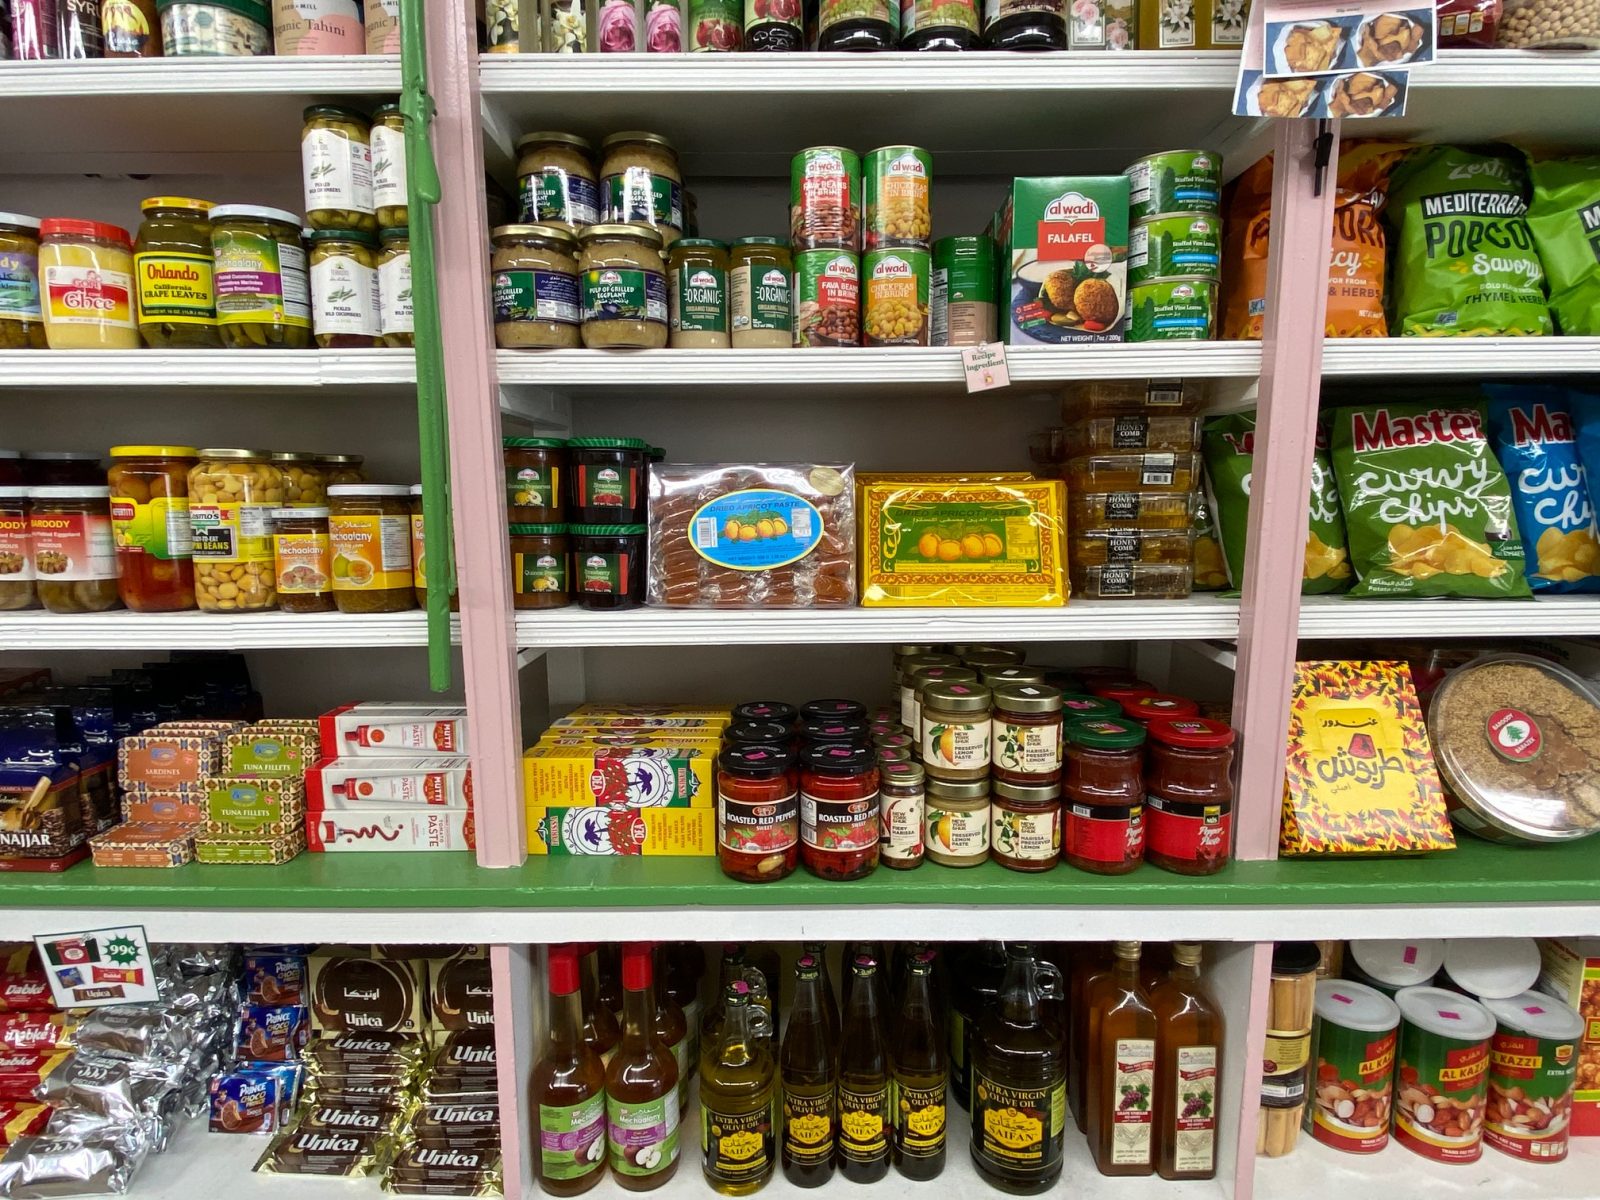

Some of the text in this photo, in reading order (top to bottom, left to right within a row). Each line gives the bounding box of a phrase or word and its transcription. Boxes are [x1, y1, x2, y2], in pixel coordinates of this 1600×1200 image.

[304, 19, 346, 37] Tahini
[892, 161, 922, 173] al wadi
[1050, 202, 1093, 215] al wadi
[1047, 233, 1095, 244] FALAFEL
[829, 262, 856, 274] al wadi
[1328, 248, 1362, 276] icy
[148, 264, 199, 281] Orlando
[876, 263, 908, 274] al wadi
[1472, 254, 1542, 287] Savory
[502, 287, 523, 295] GRILLED
[611, 286, 635, 294] GRILLED
[822, 281, 859, 292] FAVA BEANS
[870, 282, 915, 292] CHICKPEAS
[1342, 287, 1381, 298] HERBS
[145, 290, 207, 300] GRAPE LEAVES
[597, 292, 626, 300] EGGPLANT
[687, 289, 720, 304] ORGANIC
[759, 287, 789, 304] ORGANIC
[838, 289, 856, 300] BRINE
[885, 289, 910, 298] BRINE
[1465, 293, 1509, 305] THYME
[63, 290, 115, 310] Ghee
[971, 352, 996, 362] Recipe
[1352, 408, 1487, 453] Master
[709, 504, 735, 512] DRIED
[736, 502, 773, 511] APRICOT
[31, 519, 71, 528] BAROODY
[203, 540, 229, 550] BEANS
[1321, 717, 1378, 728] غندور
[412, 725, 421, 746] PASTE
[1316, 745, 1405, 790] طربوش
[402, 778, 410, 800] PASTE
[591, 776, 602, 790] DEA
[727, 809, 797, 825] ROASTED RED PEPPERS
[819, 812, 866, 823] ROASTED RED
[428, 815, 439, 847] PASTE
[634, 824, 644, 839] DEA
[0, 833, 51, 849] NAJJAR
[110, 945, 136, 956] 99¢
[275, 961, 299, 973] PRINCE
[266, 1012, 290, 1025] PRINCE
[345, 1013, 383, 1027] Unica
[334, 1037, 392, 1051] Unica
[1361, 1063, 1374, 1071] AL
[1500, 1056, 1537, 1067] KAZZI
[1442, 1071, 1456, 1079] AL
[239, 1082, 267, 1096] PRINCE
[904, 1090, 928, 1100] EXTRA
[981, 1079, 1047, 1100] EXTRA VIRGIN
[240, 1092, 267, 1104] CHOCO
[810, 1093, 833, 1106] VIRGIN
[862, 1092, 886, 1104] VIRGIN
[911, 1097, 933, 1106] OLIVE
[988, 1091, 1037, 1108] OLIVE OIL
[792, 1103, 827, 1113] OLIVE OIL
[844, 1101, 880, 1110] OLIVE OIL
[320, 1107, 380, 1127] Unica
[434, 1104, 494, 1123] Unica
[715, 1110, 766, 1125] EXTRA VIRGIN
[722, 1120, 759, 1131] OLIVE OIL
[913, 1119, 944, 1130] SAIFAN
[792, 1128, 826, 1138] SAIFAN
[845, 1127, 878, 1136] SAIFAN
[988, 1125, 1035, 1142] SAIFAN
[299, 1133, 360, 1152] Unica
[723, 1144, 759, 1155] SAIFAN
[417, 1148, 479, 1168] Unica
